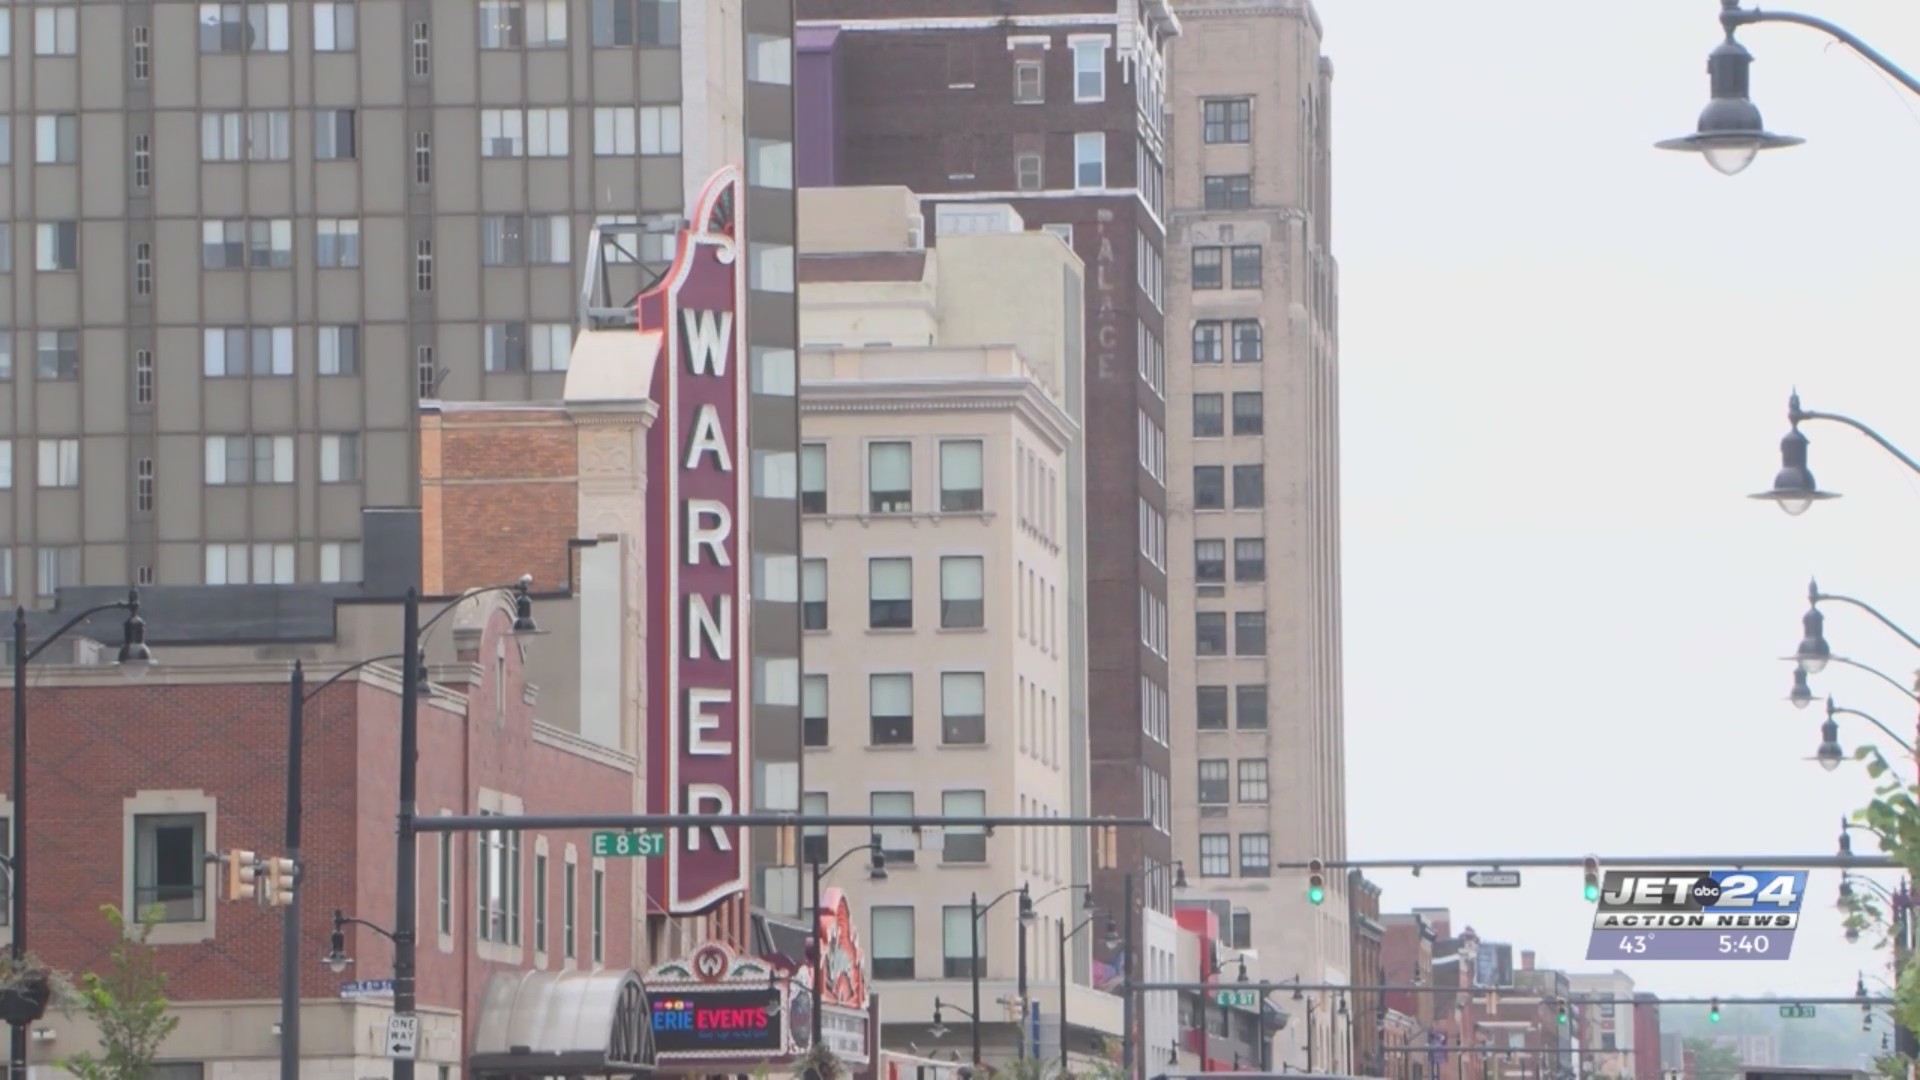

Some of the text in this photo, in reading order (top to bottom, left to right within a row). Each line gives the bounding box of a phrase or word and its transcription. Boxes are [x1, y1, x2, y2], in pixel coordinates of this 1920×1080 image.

[1097, 209, 1117, 379] PALACE
[681, 308, 733, 852] WARNER
[595, 833, 664, 854] E 8 ST
[1217, 993, 1225, 1005] E
[1229, 993, 1237, 1005] 9
[391, 1019, 415, 1029] ONE
[653, 1006, 767, 1030] ERIE EVENTS
[391, 1031, 415, 1041] WAY
